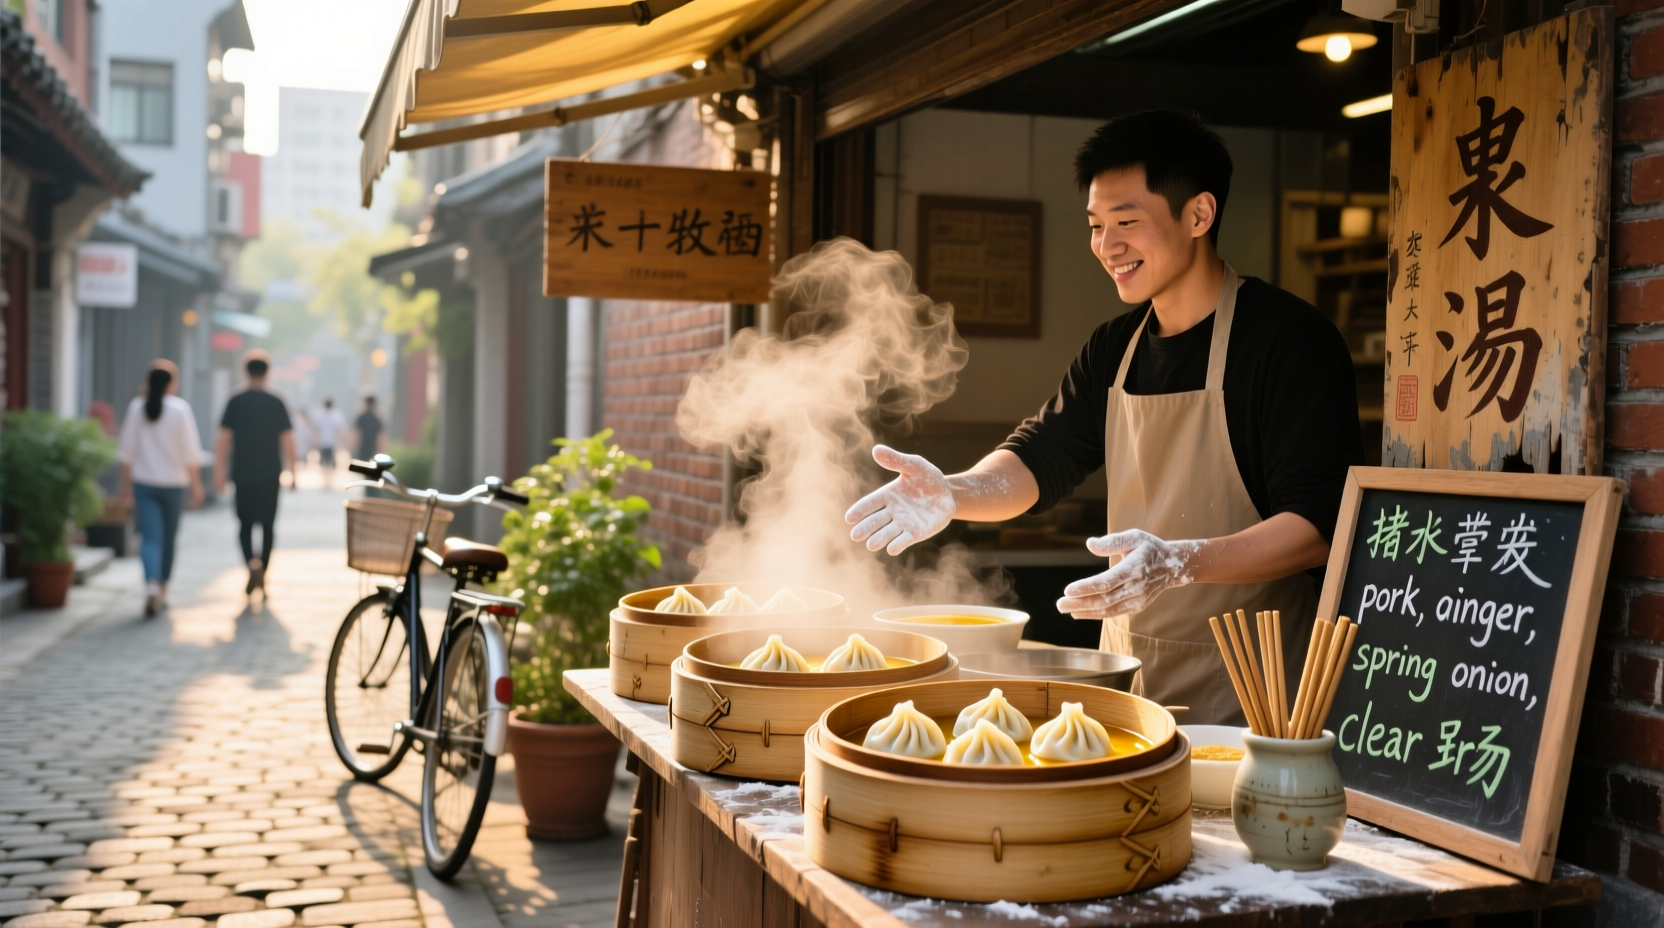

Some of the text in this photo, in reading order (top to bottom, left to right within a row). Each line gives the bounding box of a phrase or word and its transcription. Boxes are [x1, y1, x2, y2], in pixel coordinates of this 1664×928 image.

[1357, 574, 1536, 647] pork, ainger,
[1352, 643, 1537, 711] spring onion,
